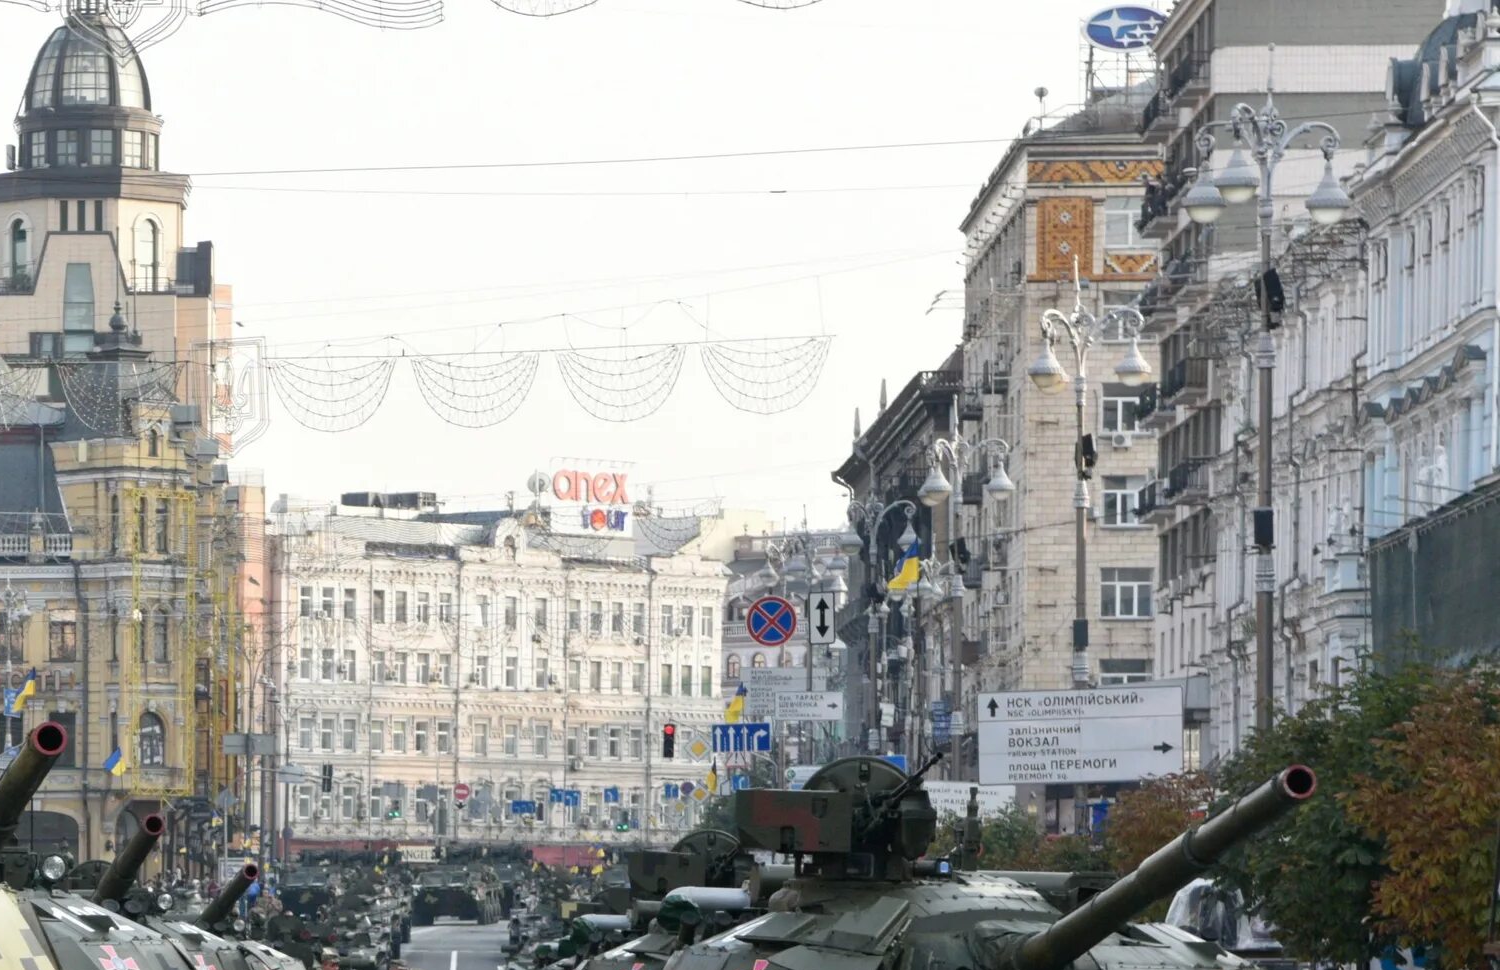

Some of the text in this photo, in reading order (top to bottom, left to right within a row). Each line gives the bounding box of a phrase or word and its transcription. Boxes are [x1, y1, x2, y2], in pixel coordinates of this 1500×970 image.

[553, 469, 629, 505] anex
[8, 671, 61, 691] СТІ
[1006, 692, 1144, 708] НСК «ОЛІМПІЙСЬКИЙ»
[1007, 709, 1024, 718] NSC
[1008, 725, 1081, 736] залізничний
[1008, 736, 1060, 748] ВОКЗАЛ
[1040, 748, 1077, 757] STATION
[1008, 758, 1117, 772] площа ПЕРЕМОГИ
[1008, 773, 1053, 781] PEREMOHY
